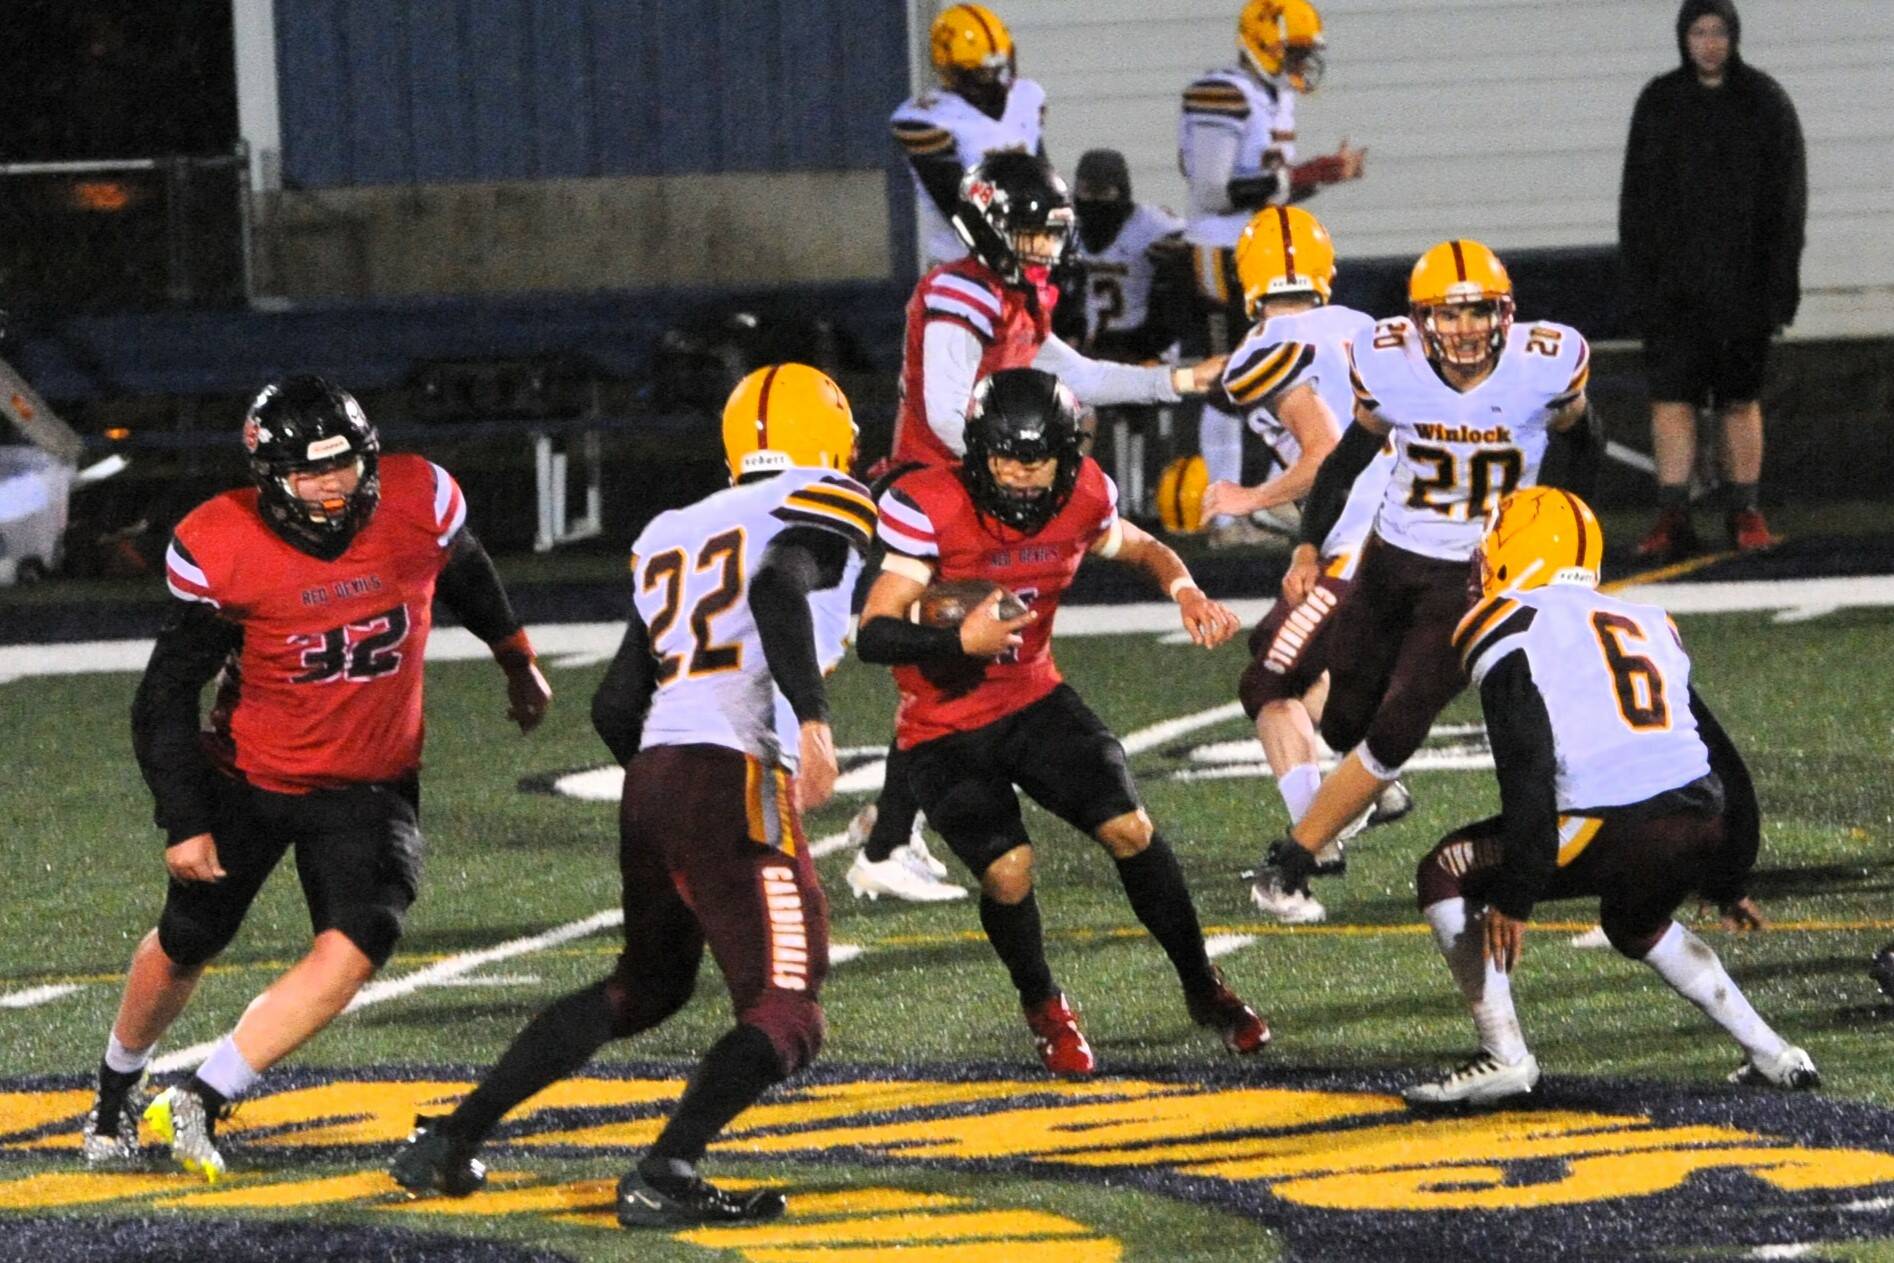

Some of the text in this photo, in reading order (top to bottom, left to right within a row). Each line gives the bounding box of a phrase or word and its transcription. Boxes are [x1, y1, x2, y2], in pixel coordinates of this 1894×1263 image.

[1413, 422, 1512, 443] Winlock
[1406, 442, 1524, 520] 20
[302, 575, 382, 605] RED DEVILS
[642, 526, 748, 688] 22
[1263, 585, 1338, 675] CARDINALS
[286, 603, 411, 684] 32
[1588, 609, 1673, 733] 6
[761, 866, 808, 991] CARDINALS
